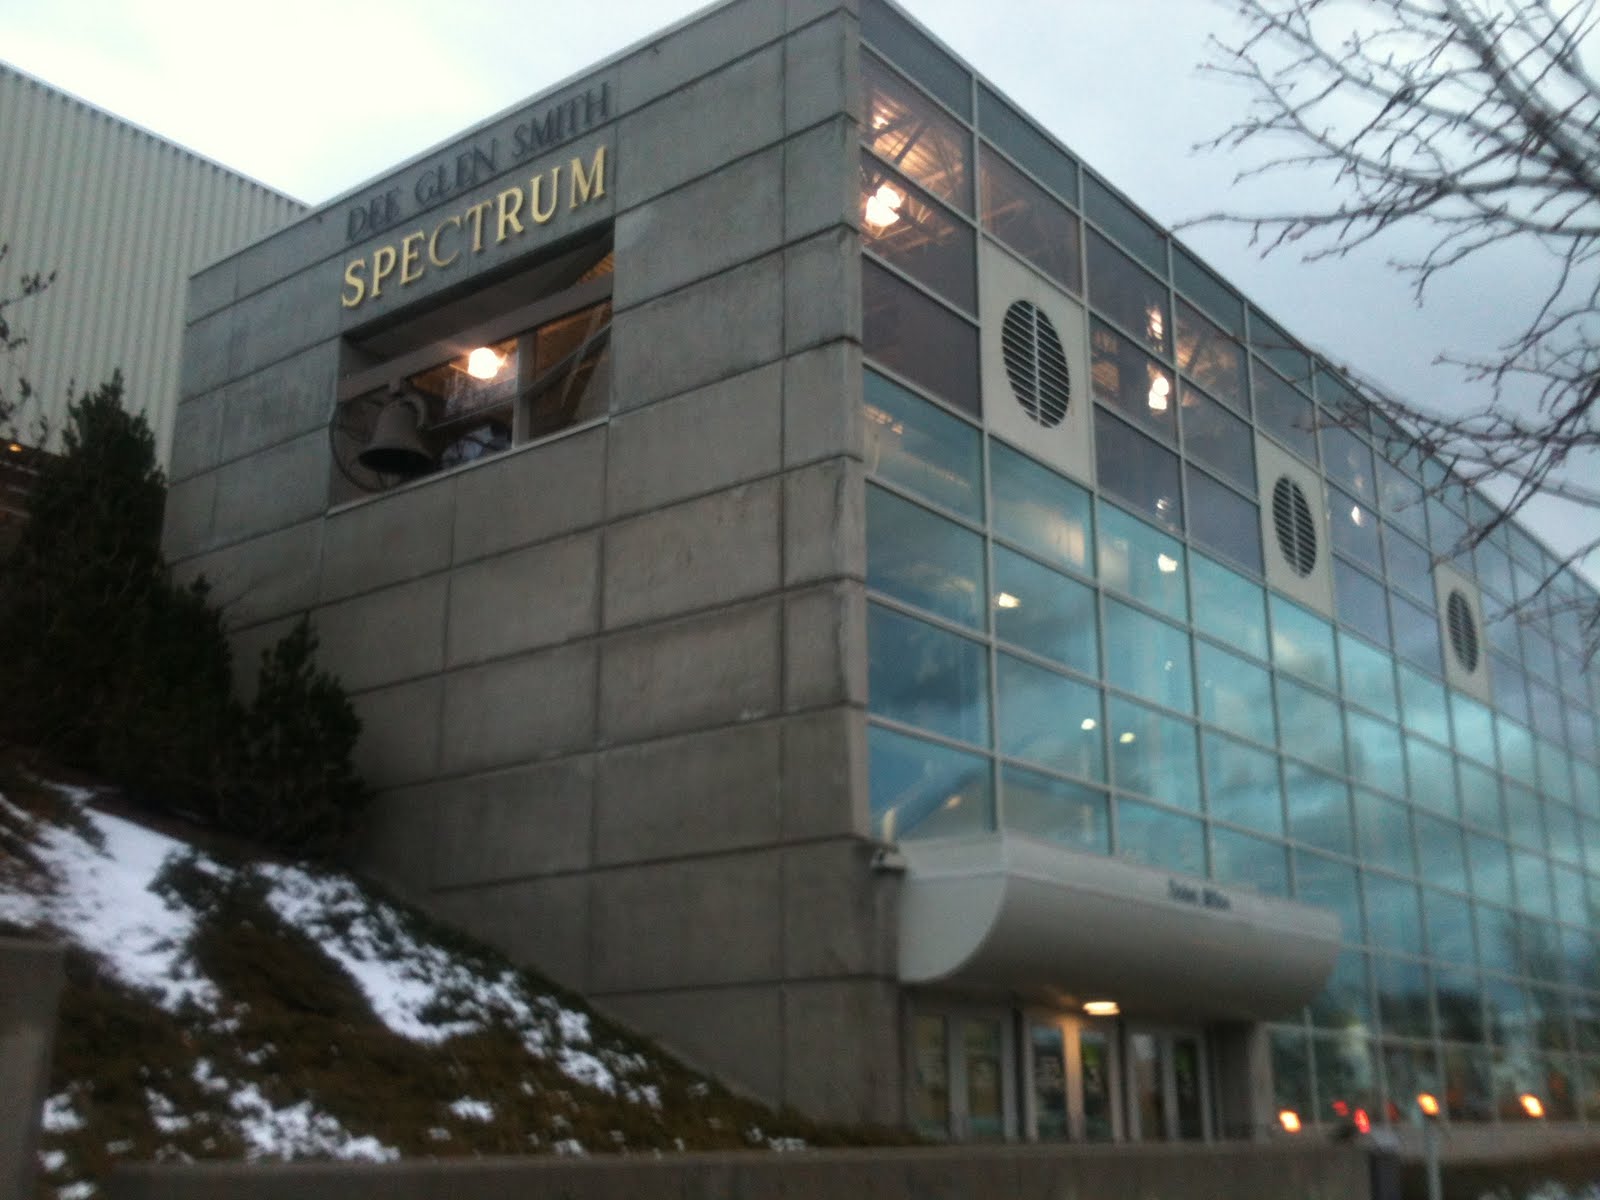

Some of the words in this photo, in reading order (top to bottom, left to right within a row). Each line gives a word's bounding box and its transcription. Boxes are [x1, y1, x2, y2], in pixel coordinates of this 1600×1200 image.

[342, 145, 606, 307] SPECTRUM
[346, 187, 399, 242] DEE
[414, 138, 498, 204] GLEN
[512, 81, 610, 158] SMITH
